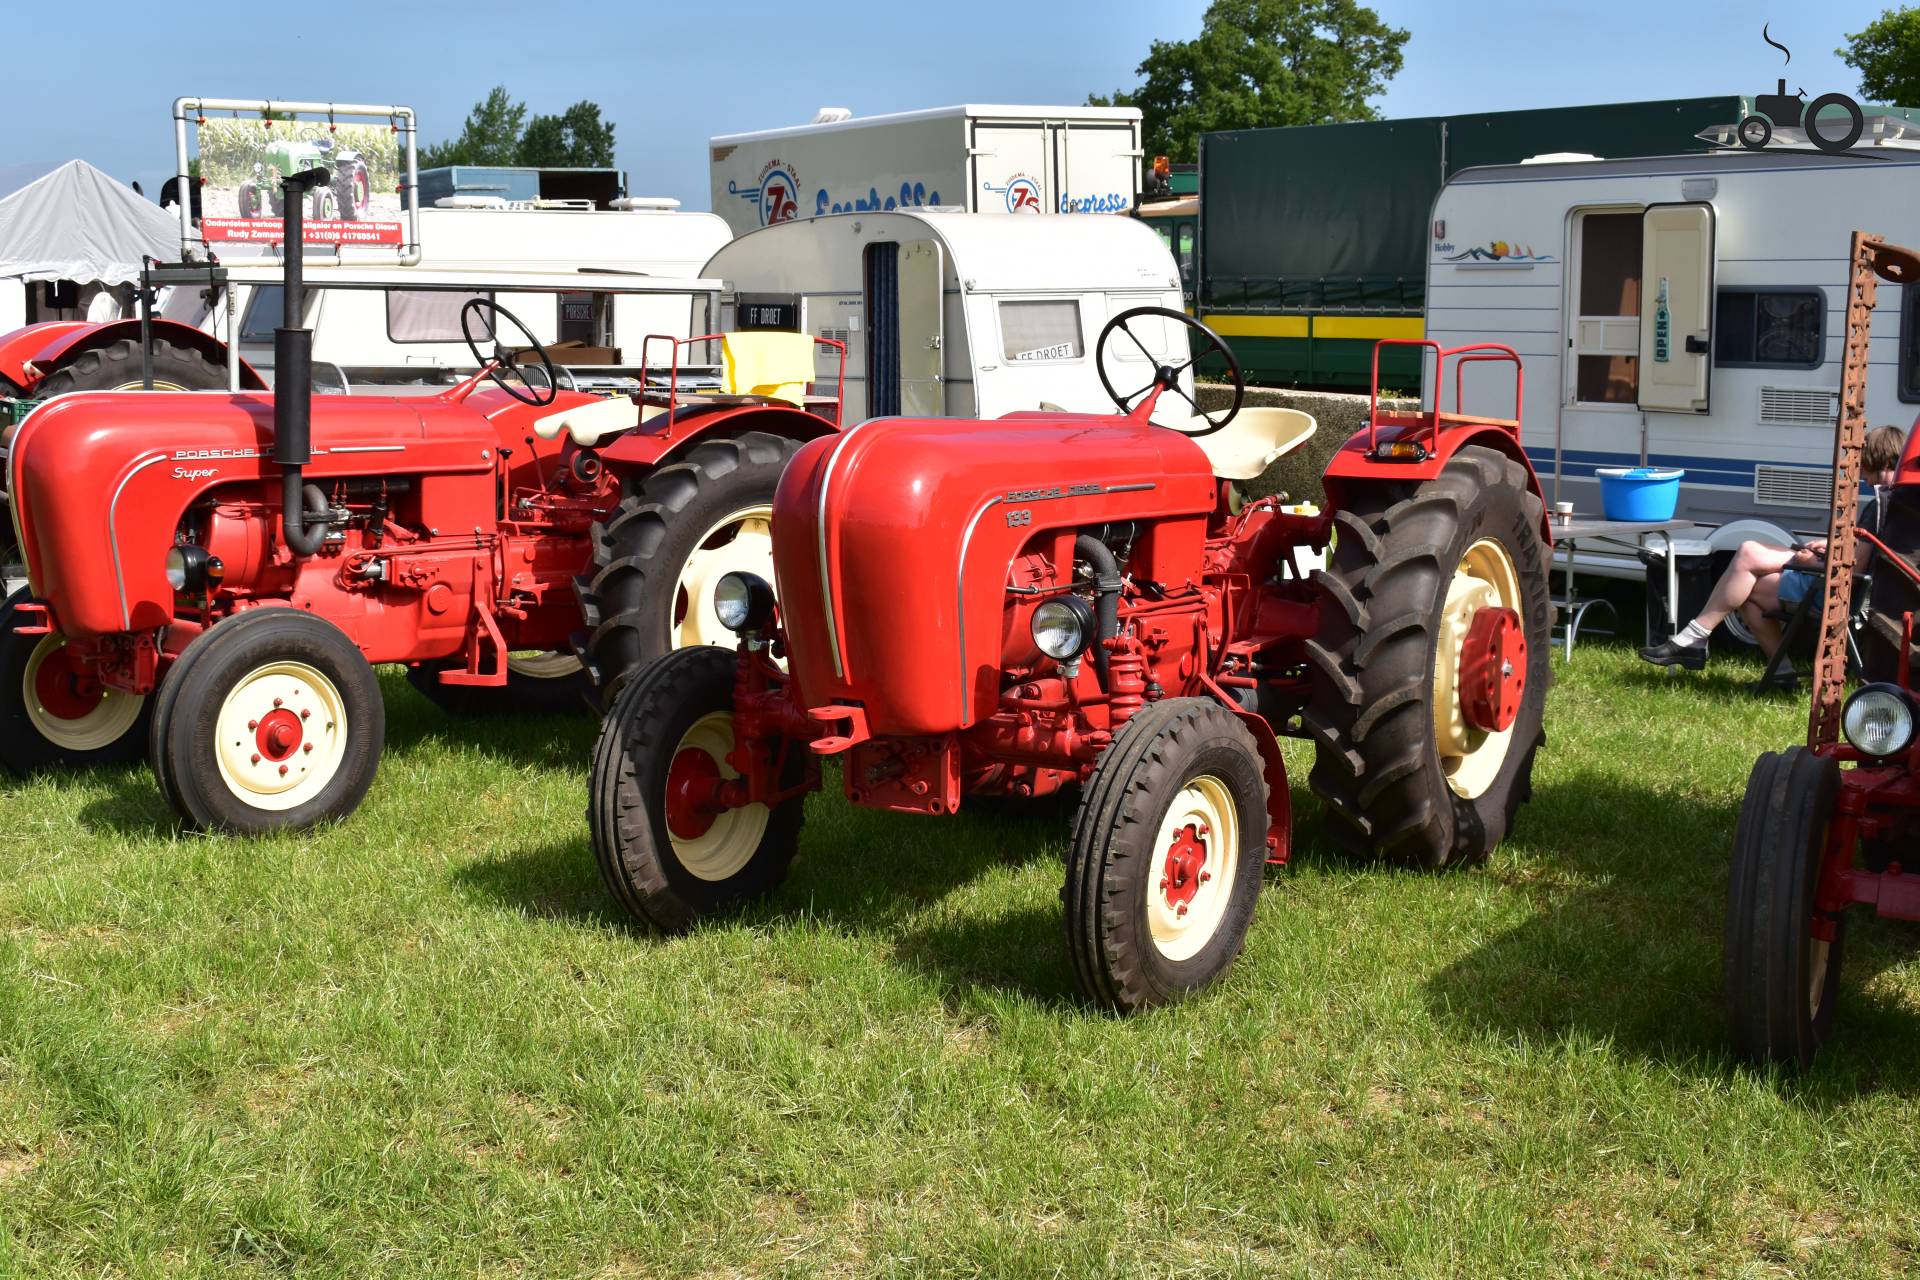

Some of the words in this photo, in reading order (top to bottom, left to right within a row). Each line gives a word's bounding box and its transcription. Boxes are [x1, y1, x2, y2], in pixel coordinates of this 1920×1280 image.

[205, 219, 250, 228] Onderdelen
[251, 221, 283, 230] verkoop
[344, 222, 374, 230] Porsche
[227, 230, 249, 239] Rudy
[1434, 242, 1455, 254] Hobby
[750, 307, 758, 324] FF
[761, 308, 781, 325] DROET
[1656, 321, 1667, 357] OPEN
[1036, 344, 1069, 360] DROET
[175, 448, 255, 459] PORSCHE
[172, 467, 219, 481] Super
[1008, 488, 1060, 500] PORSCHE
[1006, 509, 1031, 528] 133
